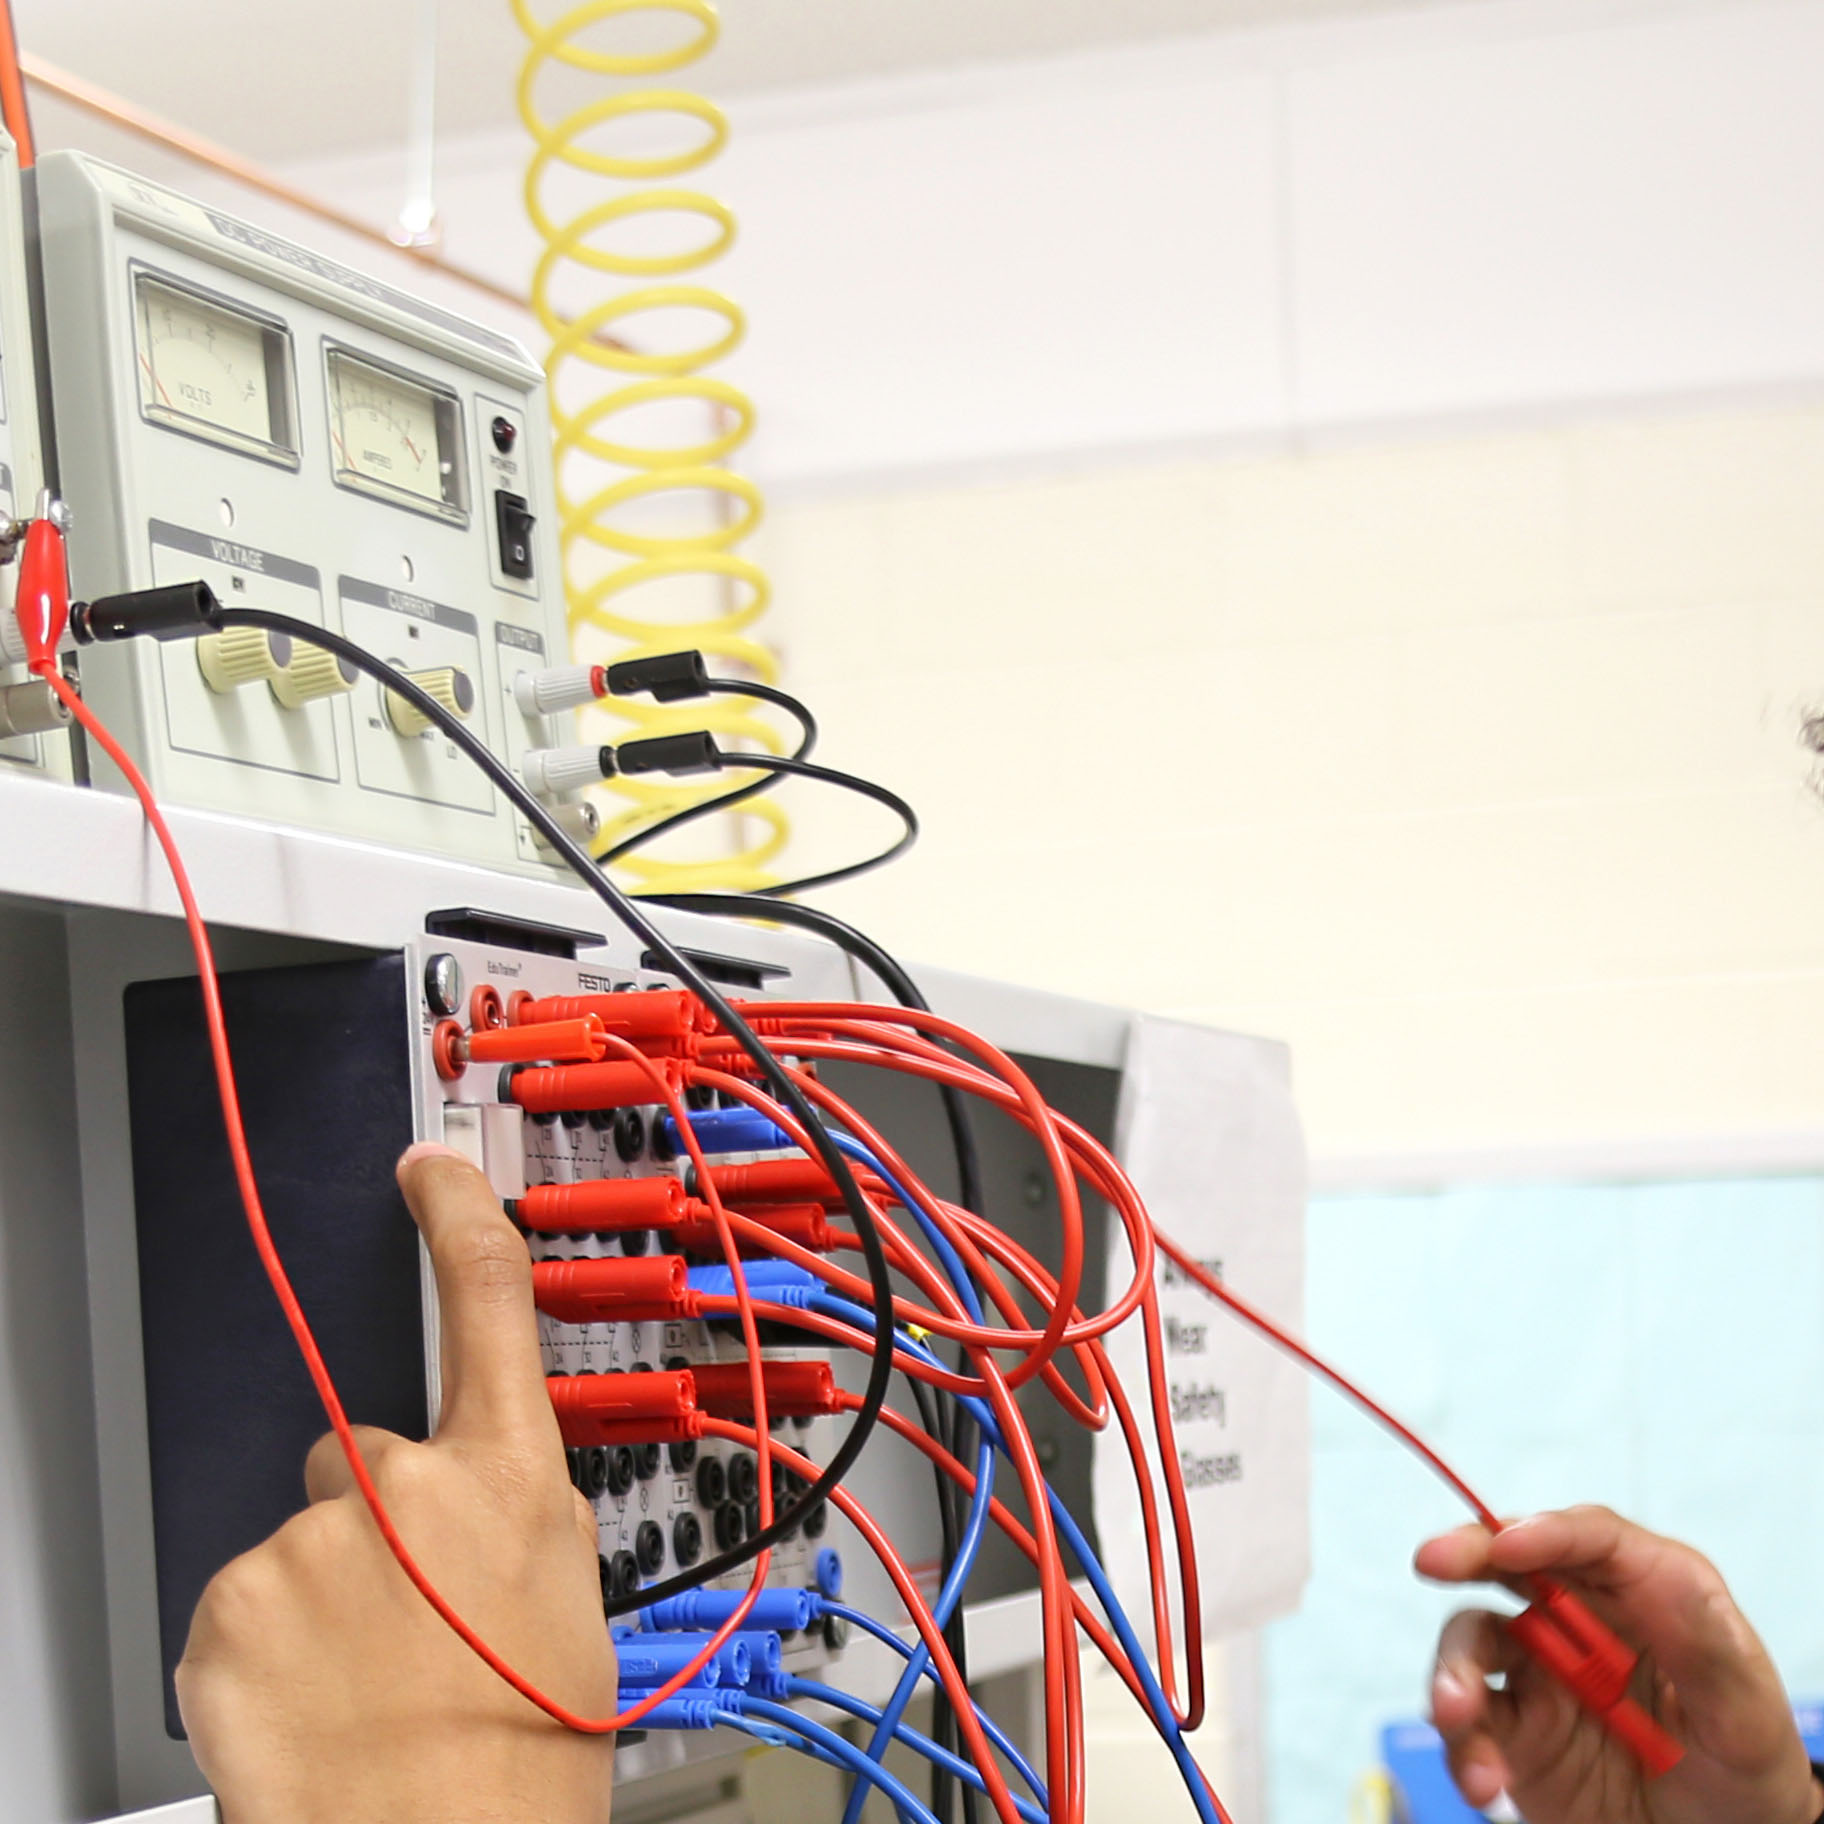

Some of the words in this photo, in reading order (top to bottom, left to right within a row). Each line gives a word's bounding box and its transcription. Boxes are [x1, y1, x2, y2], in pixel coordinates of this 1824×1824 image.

[209, 538, 265, 572] VOLTAGE
[386, 591, 437, 622] CURRENT
[577, 972, 611, 993] FESTO
